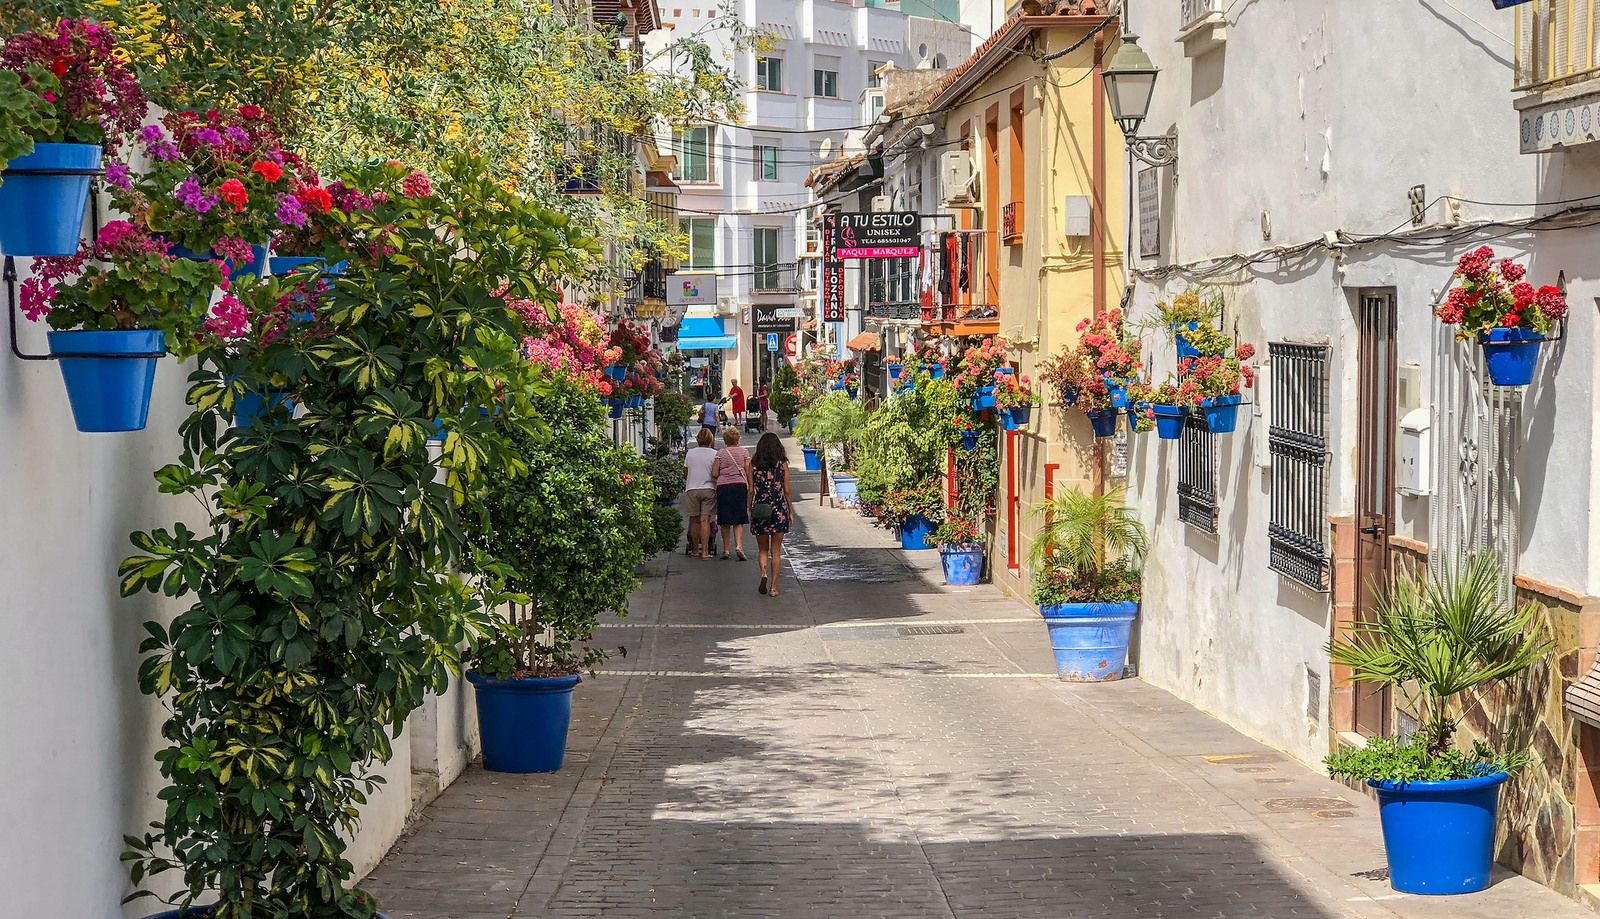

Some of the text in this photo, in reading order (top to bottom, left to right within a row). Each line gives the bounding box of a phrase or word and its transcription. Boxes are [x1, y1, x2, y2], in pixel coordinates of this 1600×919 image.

[840, 214, 915, 227] A TU ESTILO
[866, 228, 901, 236] UNISEX
[841, 248, 914, 257] PAQUI MARQUEZ
[830, 228, 838, 319] FRAN LOZANO
